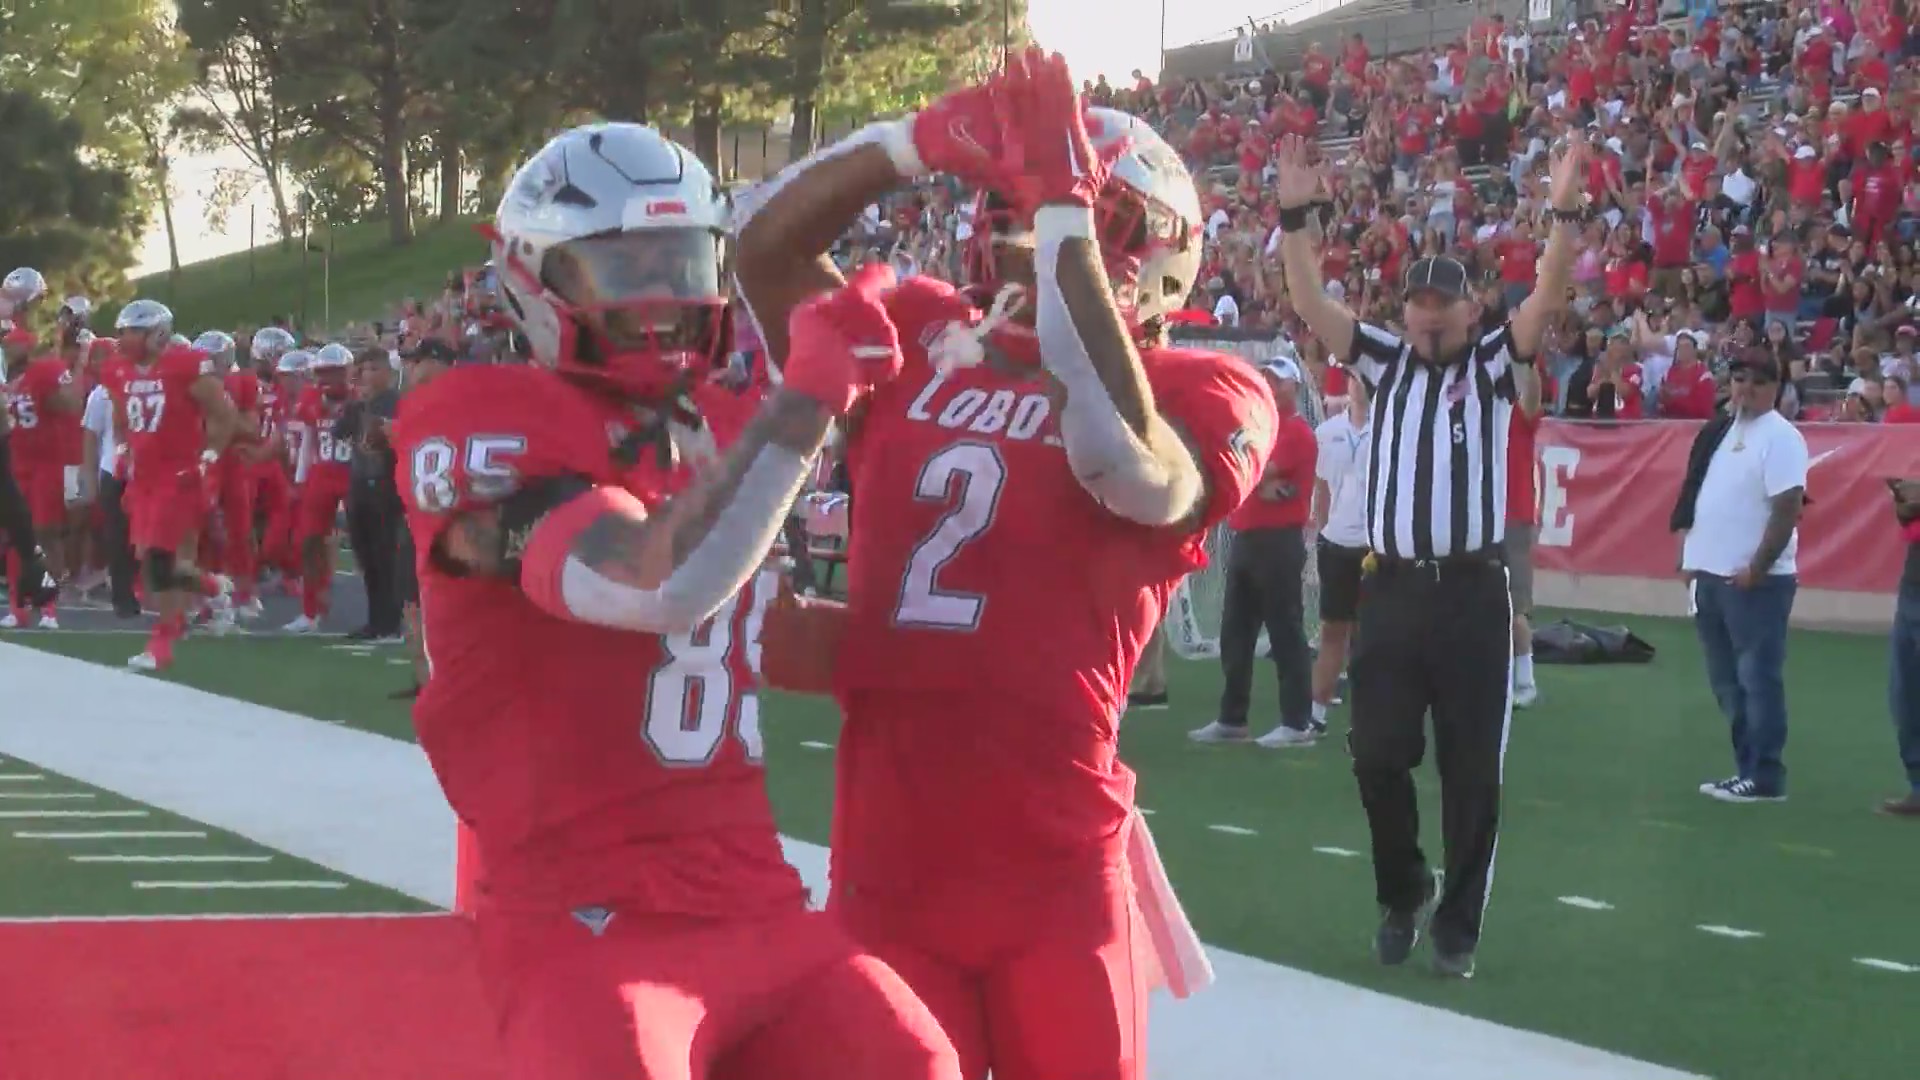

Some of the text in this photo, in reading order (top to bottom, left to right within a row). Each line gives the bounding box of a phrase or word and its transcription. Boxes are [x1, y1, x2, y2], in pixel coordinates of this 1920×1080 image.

[126, 395, 166, 433] 87
[906, 366, 1064, 447] LOBO
[411, 432, 527, 513] 85
[891, 438, 1008, 631] 2
